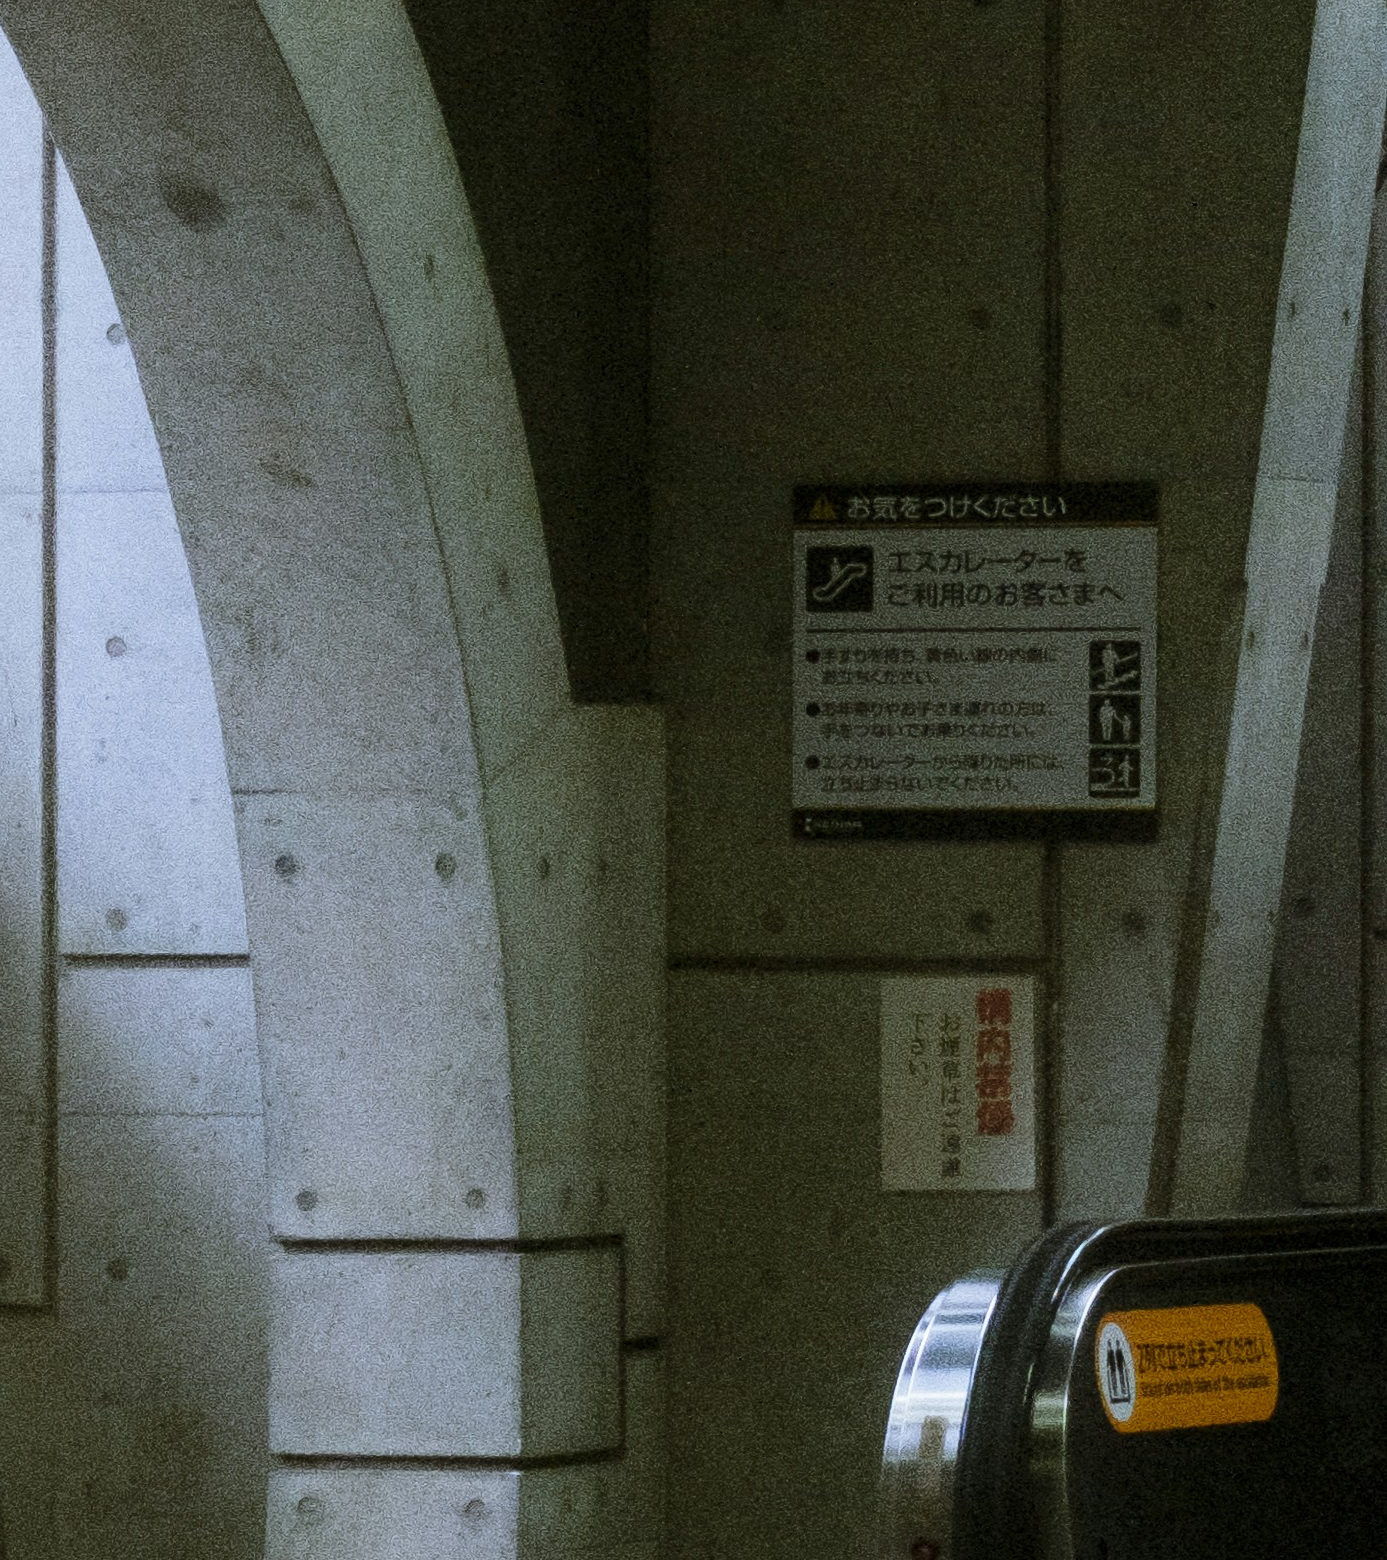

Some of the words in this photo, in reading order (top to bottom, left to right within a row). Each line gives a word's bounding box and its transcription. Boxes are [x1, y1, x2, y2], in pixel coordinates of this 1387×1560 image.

[847, 495, 1068, 520] お気をつけください
[887, 549, 1087, 574] エスカレーターを
[887, 582, 1126, 608] ご利用のお客さまへ
